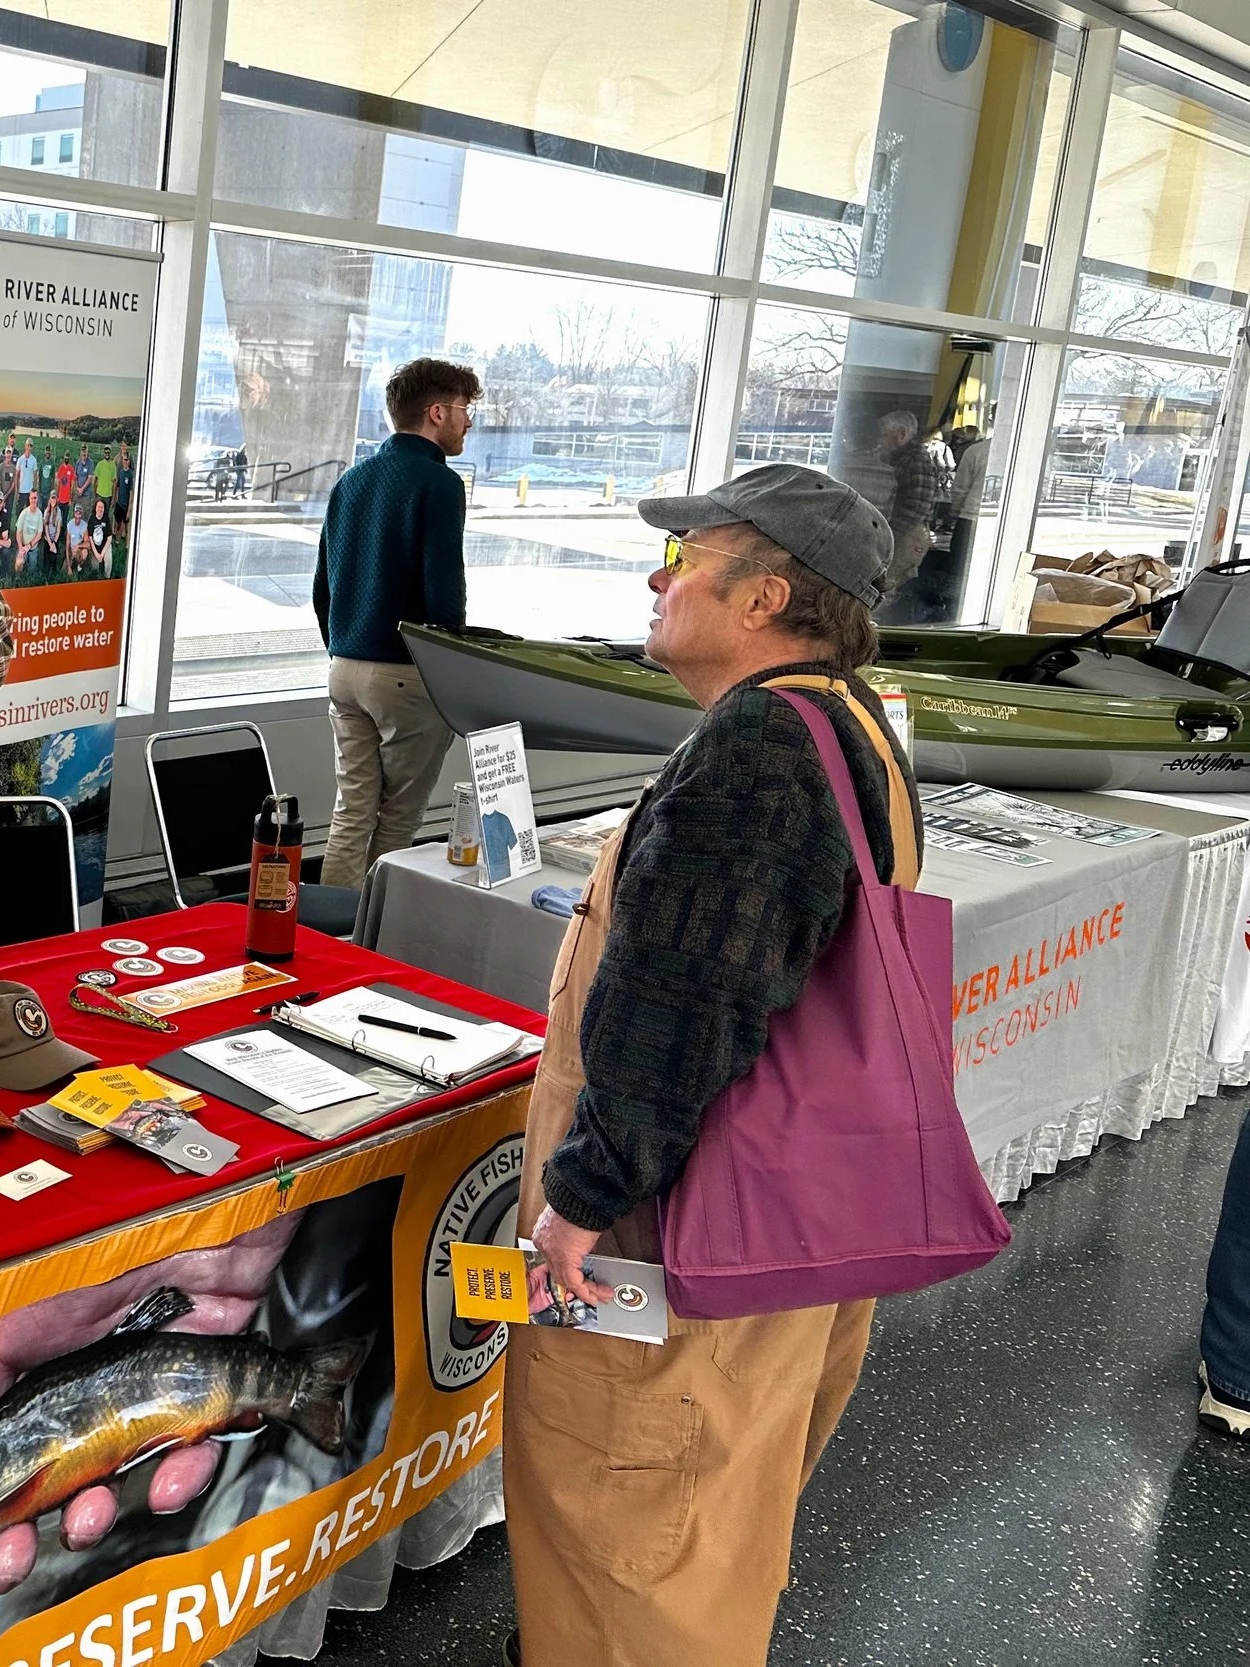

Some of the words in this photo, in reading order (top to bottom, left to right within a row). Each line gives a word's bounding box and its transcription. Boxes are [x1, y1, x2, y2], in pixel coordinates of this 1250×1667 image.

[5, 278, 56, 304] RIVER
[61, 285, 139, 312] ALLIANCE
[3, 310, 17, 329] of
[23, 311, 113, 337] WISCONSIN
[9, 611, 39, 635] ring
[42, 606, 86, 634] people
[90, 604, 105, 623] to
[22, 634, 70, 657] restore
[74, 630, 114, 649] water
[473, 745, 485, 758] Join
[485, 743, 500, 754] River
[475, 755, 497, 769] Alliance
[497, 754, 505, 764] for
[506, 750, 517, 761] $25
[1164, 752, 1249, 776] eddyline
[477, 771, 488, 782] and
[488, 768, 497, 781] get
[502, 762, 516, 775] FREE
[478, 778, 506, 794] Wisconsin
[506, 773, 525, 786] Waters
[480, 793, 499, 806] t-shirt
[951, 964, 999, 1023] VER
[1004, 901, 1126, 995] ALLIANCE
[480, 1146, 524, 1188] FISH
[439, 1326, 506, 1379] WISCONS
[9, 1538, 298, 1667] ESERVE.
[302, 1389, 500, 1577] RESTORE
